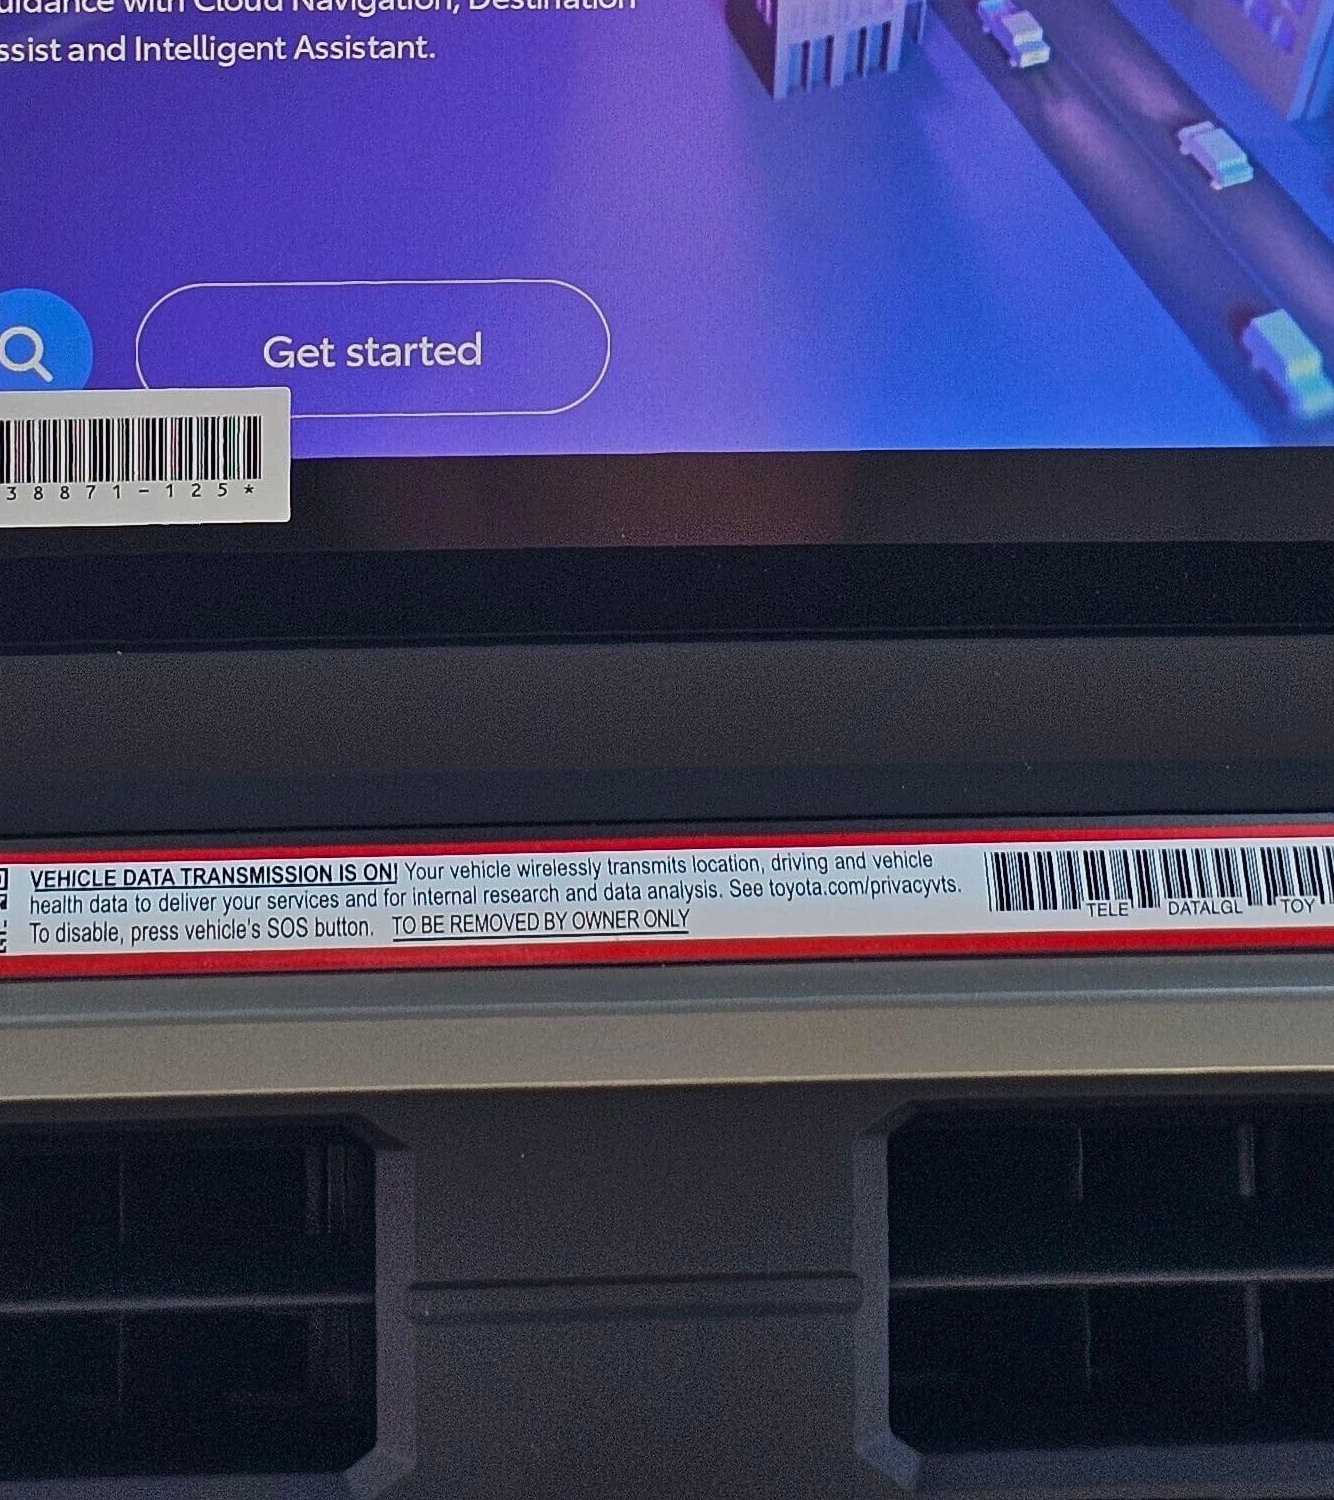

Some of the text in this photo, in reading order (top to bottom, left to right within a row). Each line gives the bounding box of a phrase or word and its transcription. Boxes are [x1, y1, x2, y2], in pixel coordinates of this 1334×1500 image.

[68, 34, 126, 62] and
[134, 33, 287, 67] Intelligent
[293, 33, 437, 61] Assistant.
[263, 331, 482, 369] Get started
[30, 869, 117, 888] VEHICLE
[123, 868, 175, 886] DATA
[181, 864, 332, 885] TRANSMISSION
[339, 863, 357, 882] IS
[405, 861, 444, 880] Your
[450, 860, 511, 879] vehicle
[517, 857, 601, 880] wirelessly
[608, 855, 686, 875] transmits
[692, 853, 765, 874] location,
[771, 852, 828, 874] driving
[835, 852, 866, 870] and
[872, 850, 933, 869] vehicle
[30, 875, 962, 916] health data to deliver your services and for internal research and data analysis. See toyota.com/privacyvts.
[1086, 897, 1315, 918] TELE DATALGL TOY
[30, 908, 690, 947] To disable, press vehicle's SOS button. TO BE REMOVED BY OWNER ONLY
